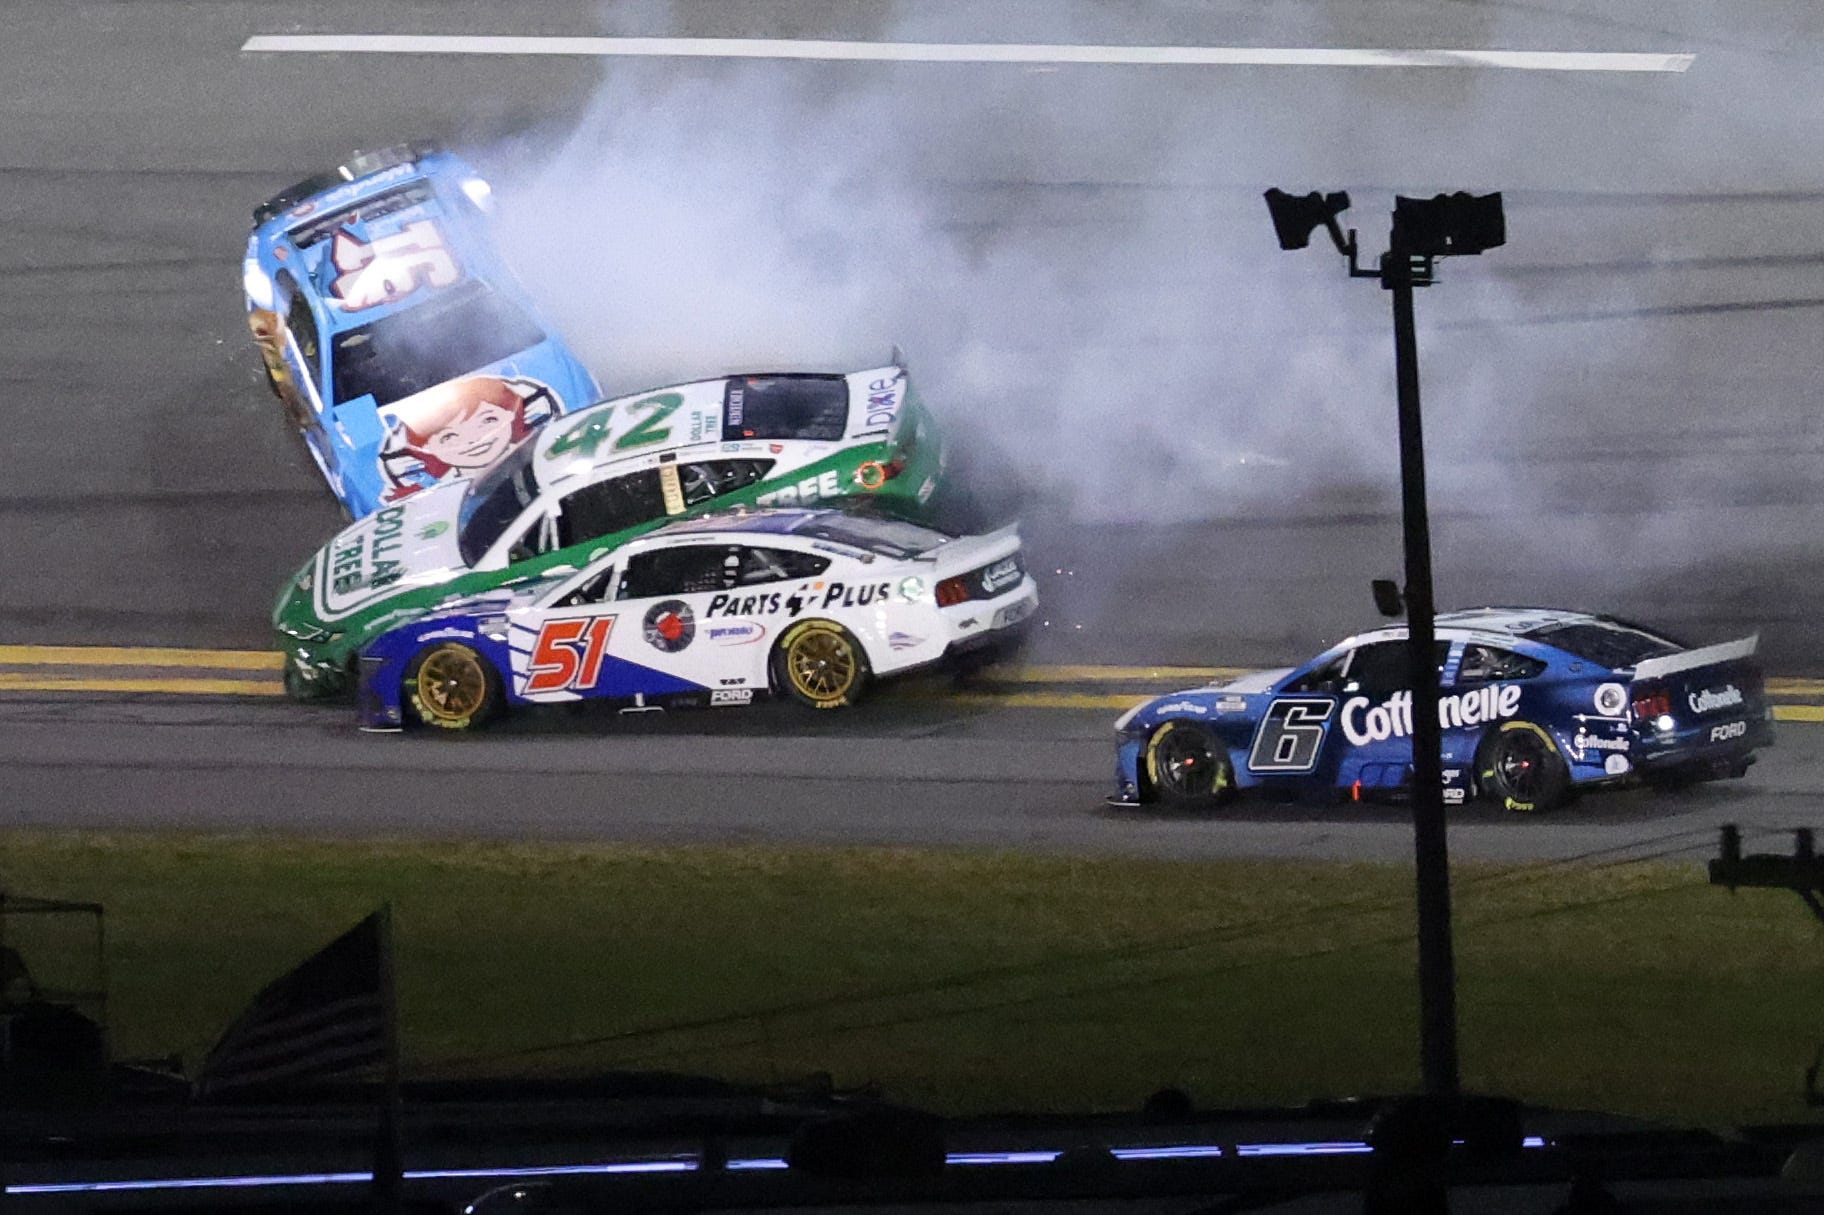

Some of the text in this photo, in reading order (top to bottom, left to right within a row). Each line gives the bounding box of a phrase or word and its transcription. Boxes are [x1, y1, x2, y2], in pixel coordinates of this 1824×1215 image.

[544, 392, 685, 461] 42
[706, 582, 891, 618] PARTS PLUS
[521, 614, 619, 695] 51
[711, 689, 754, 701] FORD
[1340, 684, 1522, 746] Cottnelle
[1248, 697, 1336, 771] 6
[1710, 720, 1747, 742] FORD
